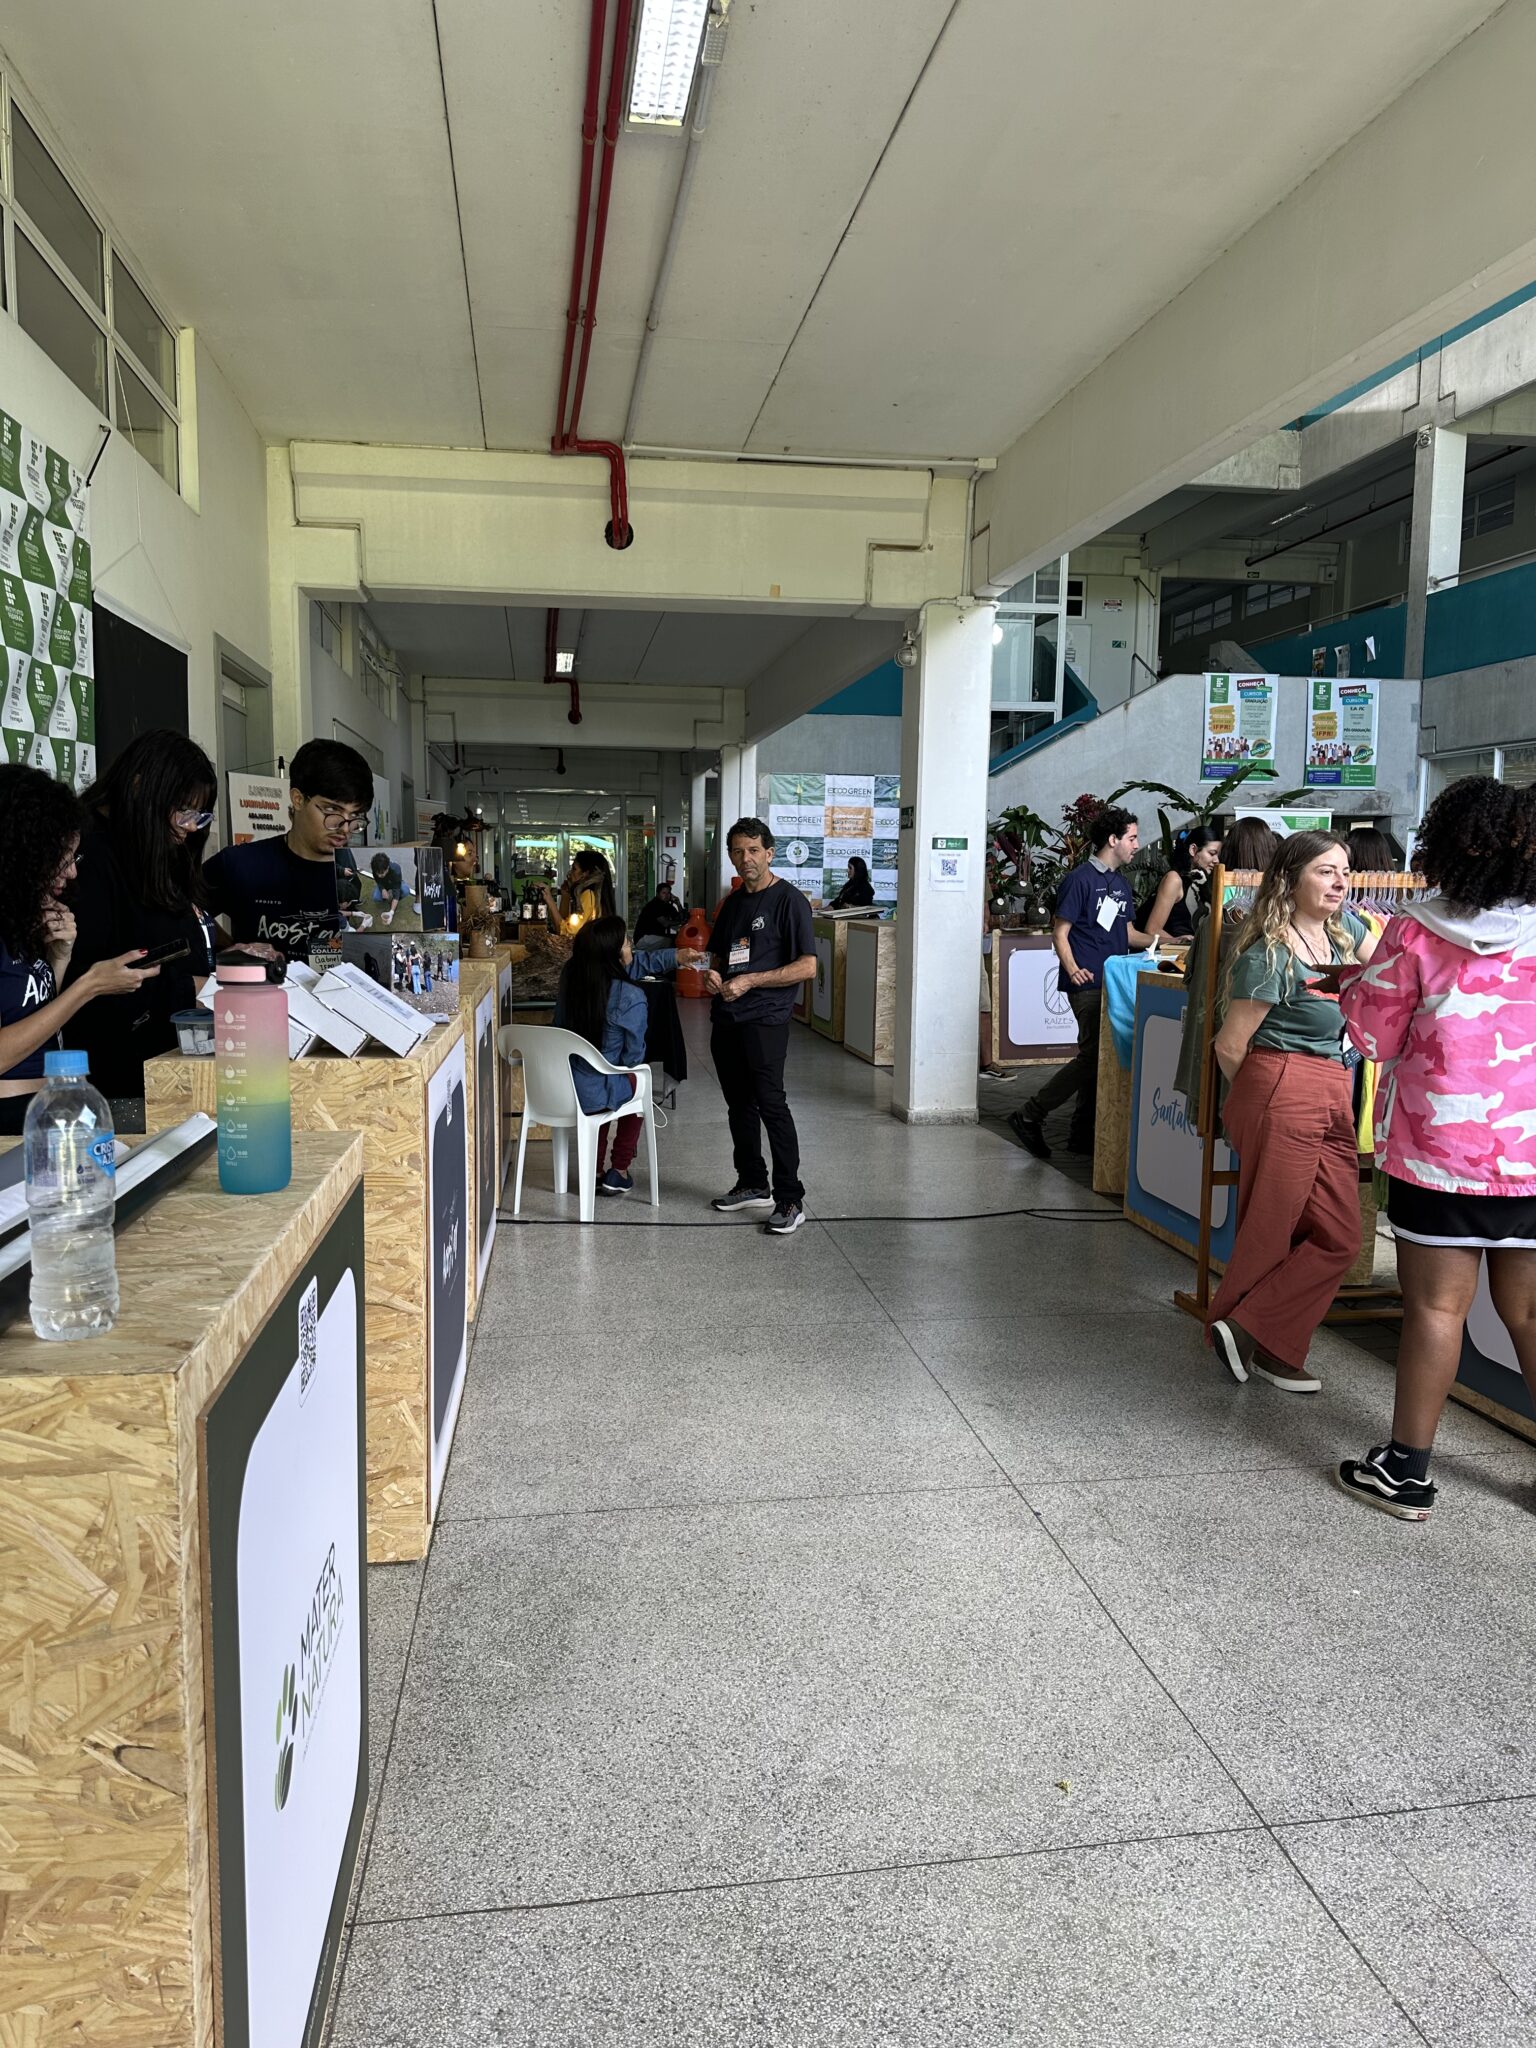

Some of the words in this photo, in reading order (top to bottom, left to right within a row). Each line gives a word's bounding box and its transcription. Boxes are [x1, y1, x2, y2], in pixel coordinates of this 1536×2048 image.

[1340, 687, 1365, 695] CONHEÇA
[240, 799, 280, 810] LUMINÁRIAS
[248, 812, 273, 820] ABAJURES
[256, 823, 286, 832] DECORAÇÃO
[1044, 1016, 1074, 1025] RAÍZES
[300, 1541, 336, 1681] MATER
[301, 1572, 344, 1739] NATURA
